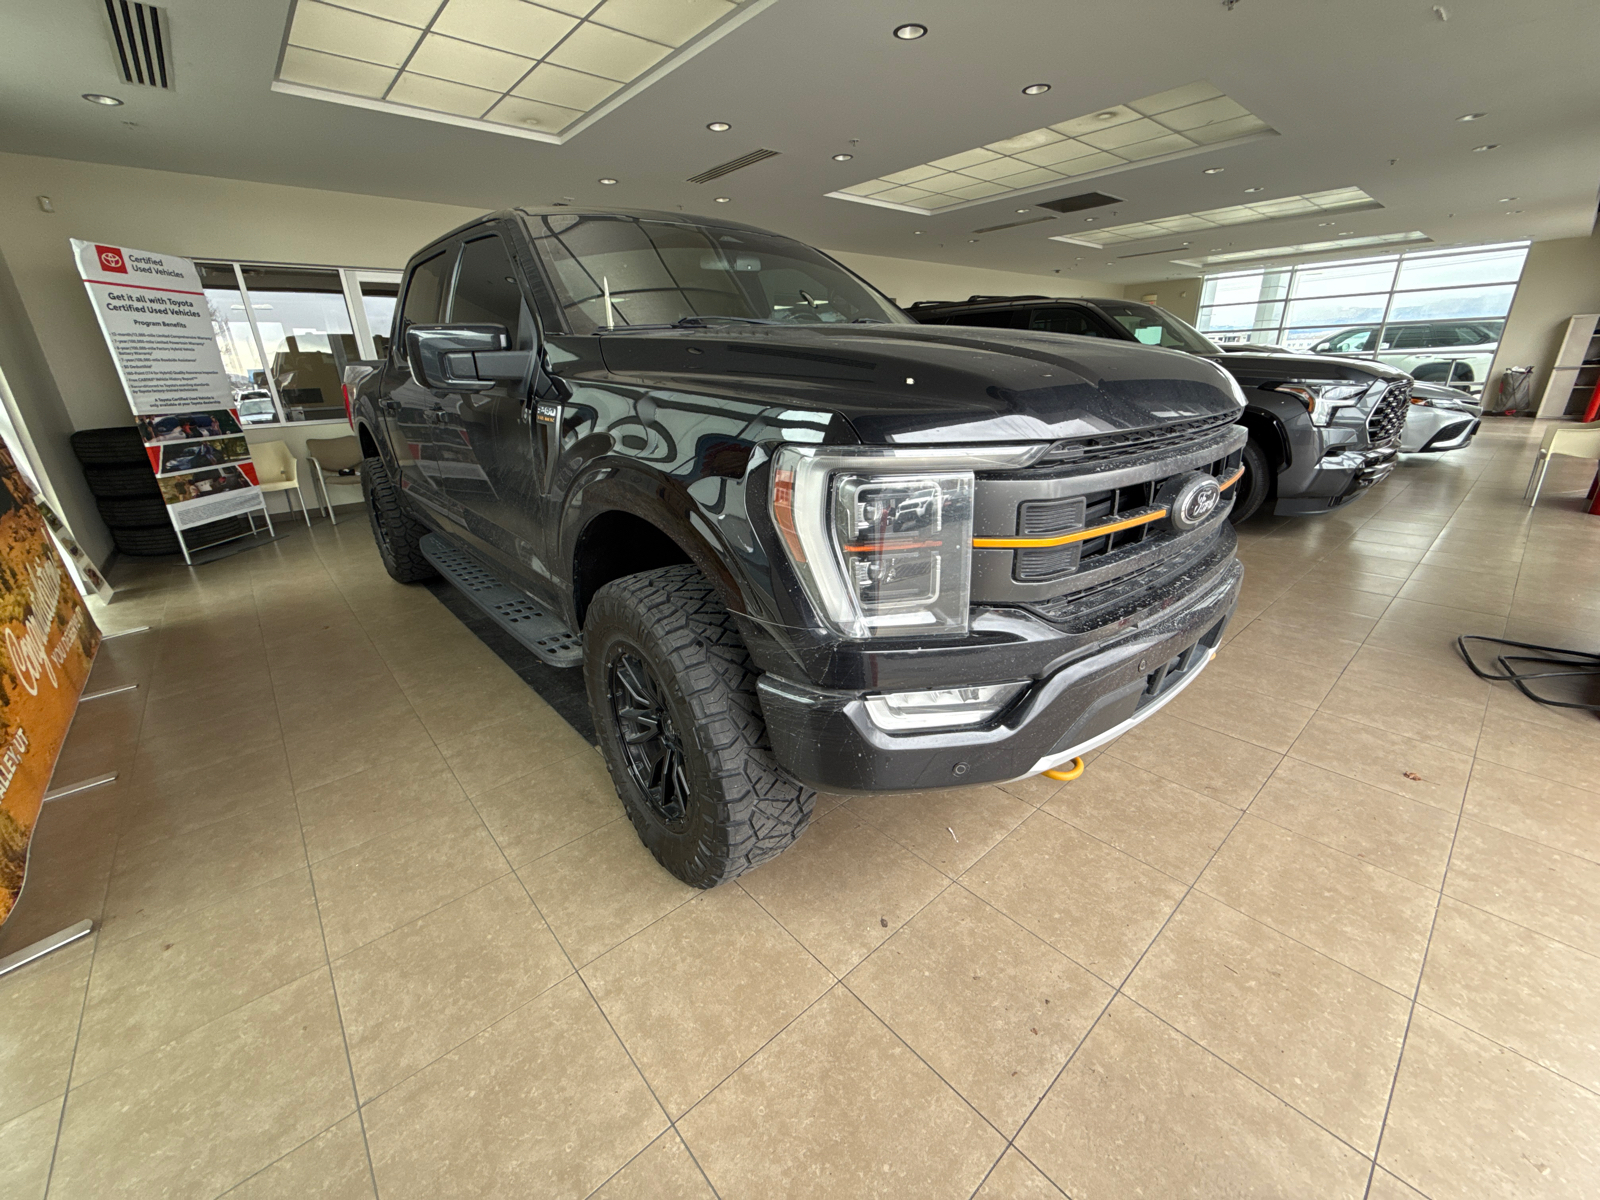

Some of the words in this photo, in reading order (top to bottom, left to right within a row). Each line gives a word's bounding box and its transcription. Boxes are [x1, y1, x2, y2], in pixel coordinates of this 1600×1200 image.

[128, 254, 163, 266] Certified
[131, 264, 153, 274] Used
[153, 267, 185, 279] Vehicles
[107, 292, 126, 302] Get
[126, 293, 134, 302] it
[135, 295, 148, 304] all
[147, 296, 167, 305] with
[166, 298, 194, 308] Toyota
[106, 302, 147, 314] Certified
[146, 306, 169, 315] Used
[168, 307, 201, 318] Vehicles
[133, 319, 162, 328] Program
[161, 321, 187, 329] Benefits
[1194, 490, 1216, 516] Ford
[13, 727, 29, 753] UT
